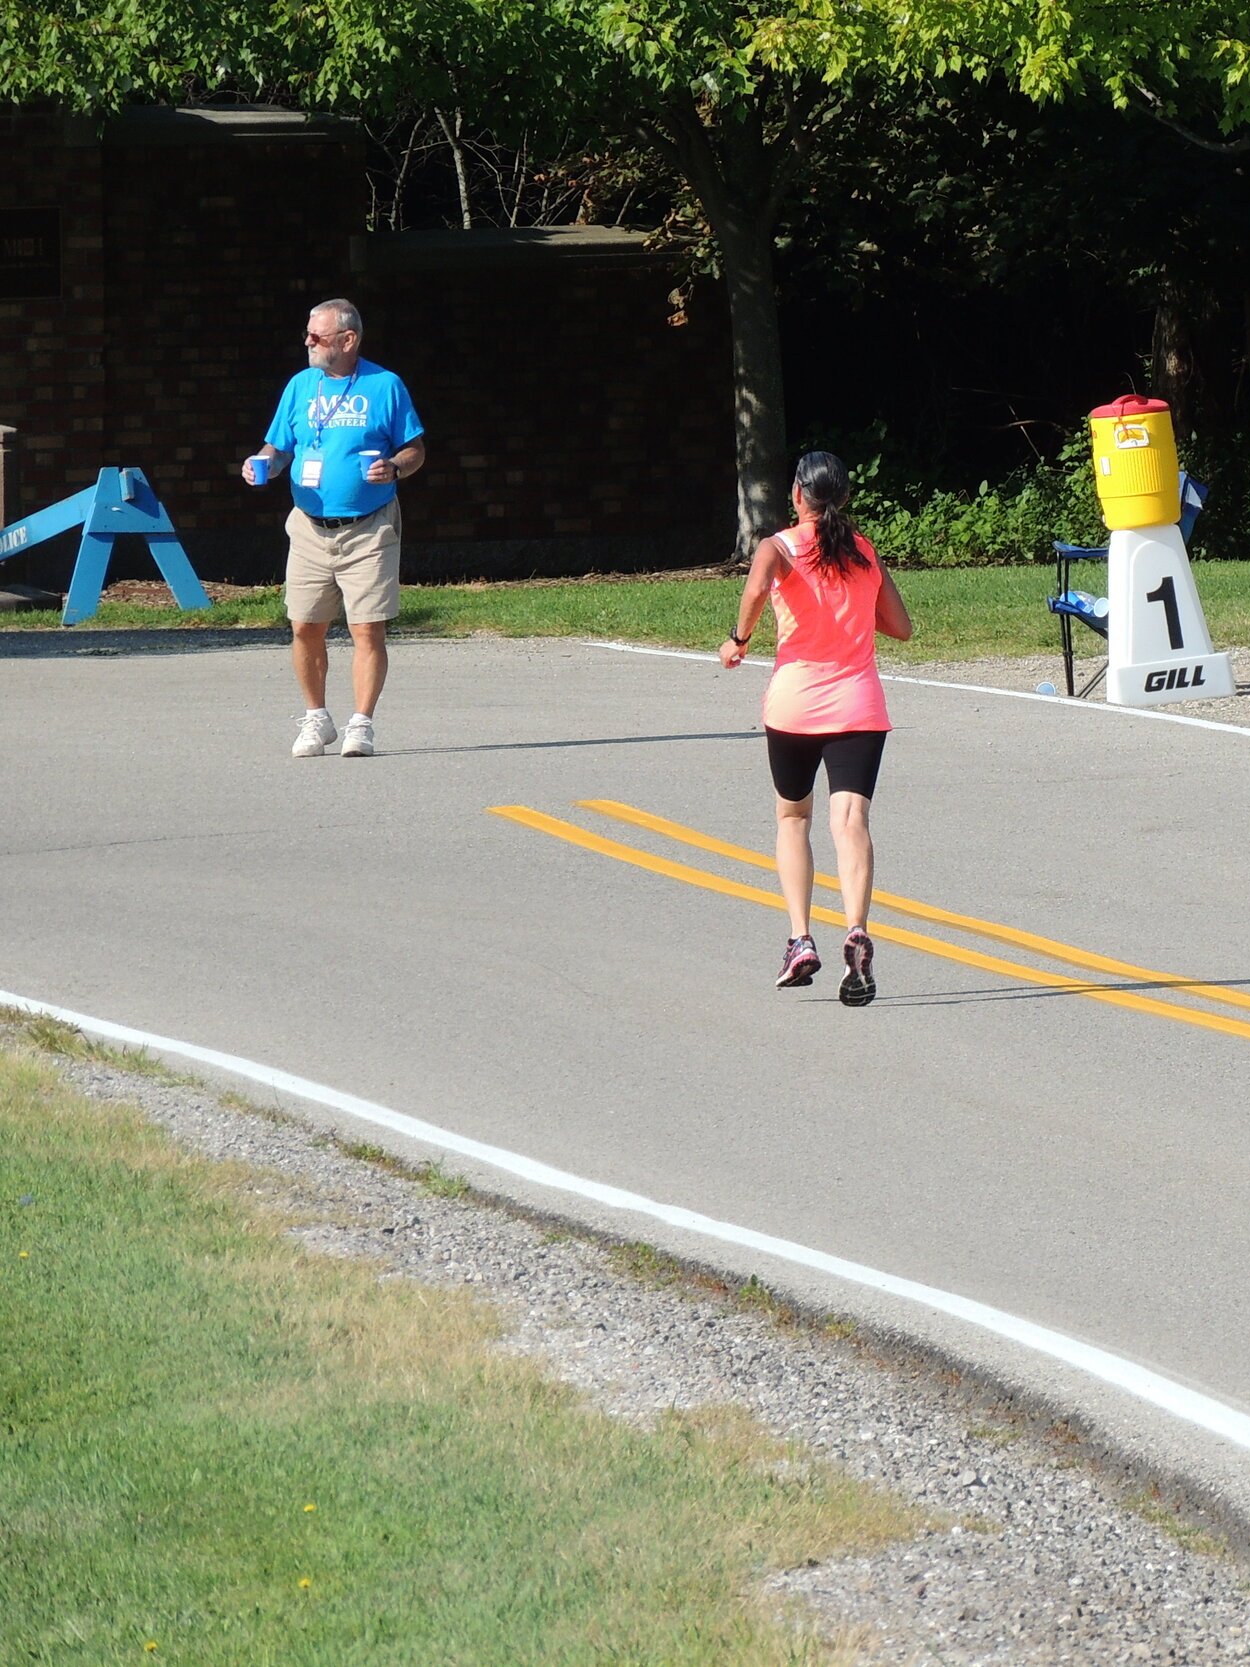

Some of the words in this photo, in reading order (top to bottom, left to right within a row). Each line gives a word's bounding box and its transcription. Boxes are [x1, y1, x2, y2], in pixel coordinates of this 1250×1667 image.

[318, 394, 368, 414] MSO
[0, 525, 27, 555] LICE
[1146, 575, 1184, 650] 1
[1144, 665, 1206, 693] GILL
